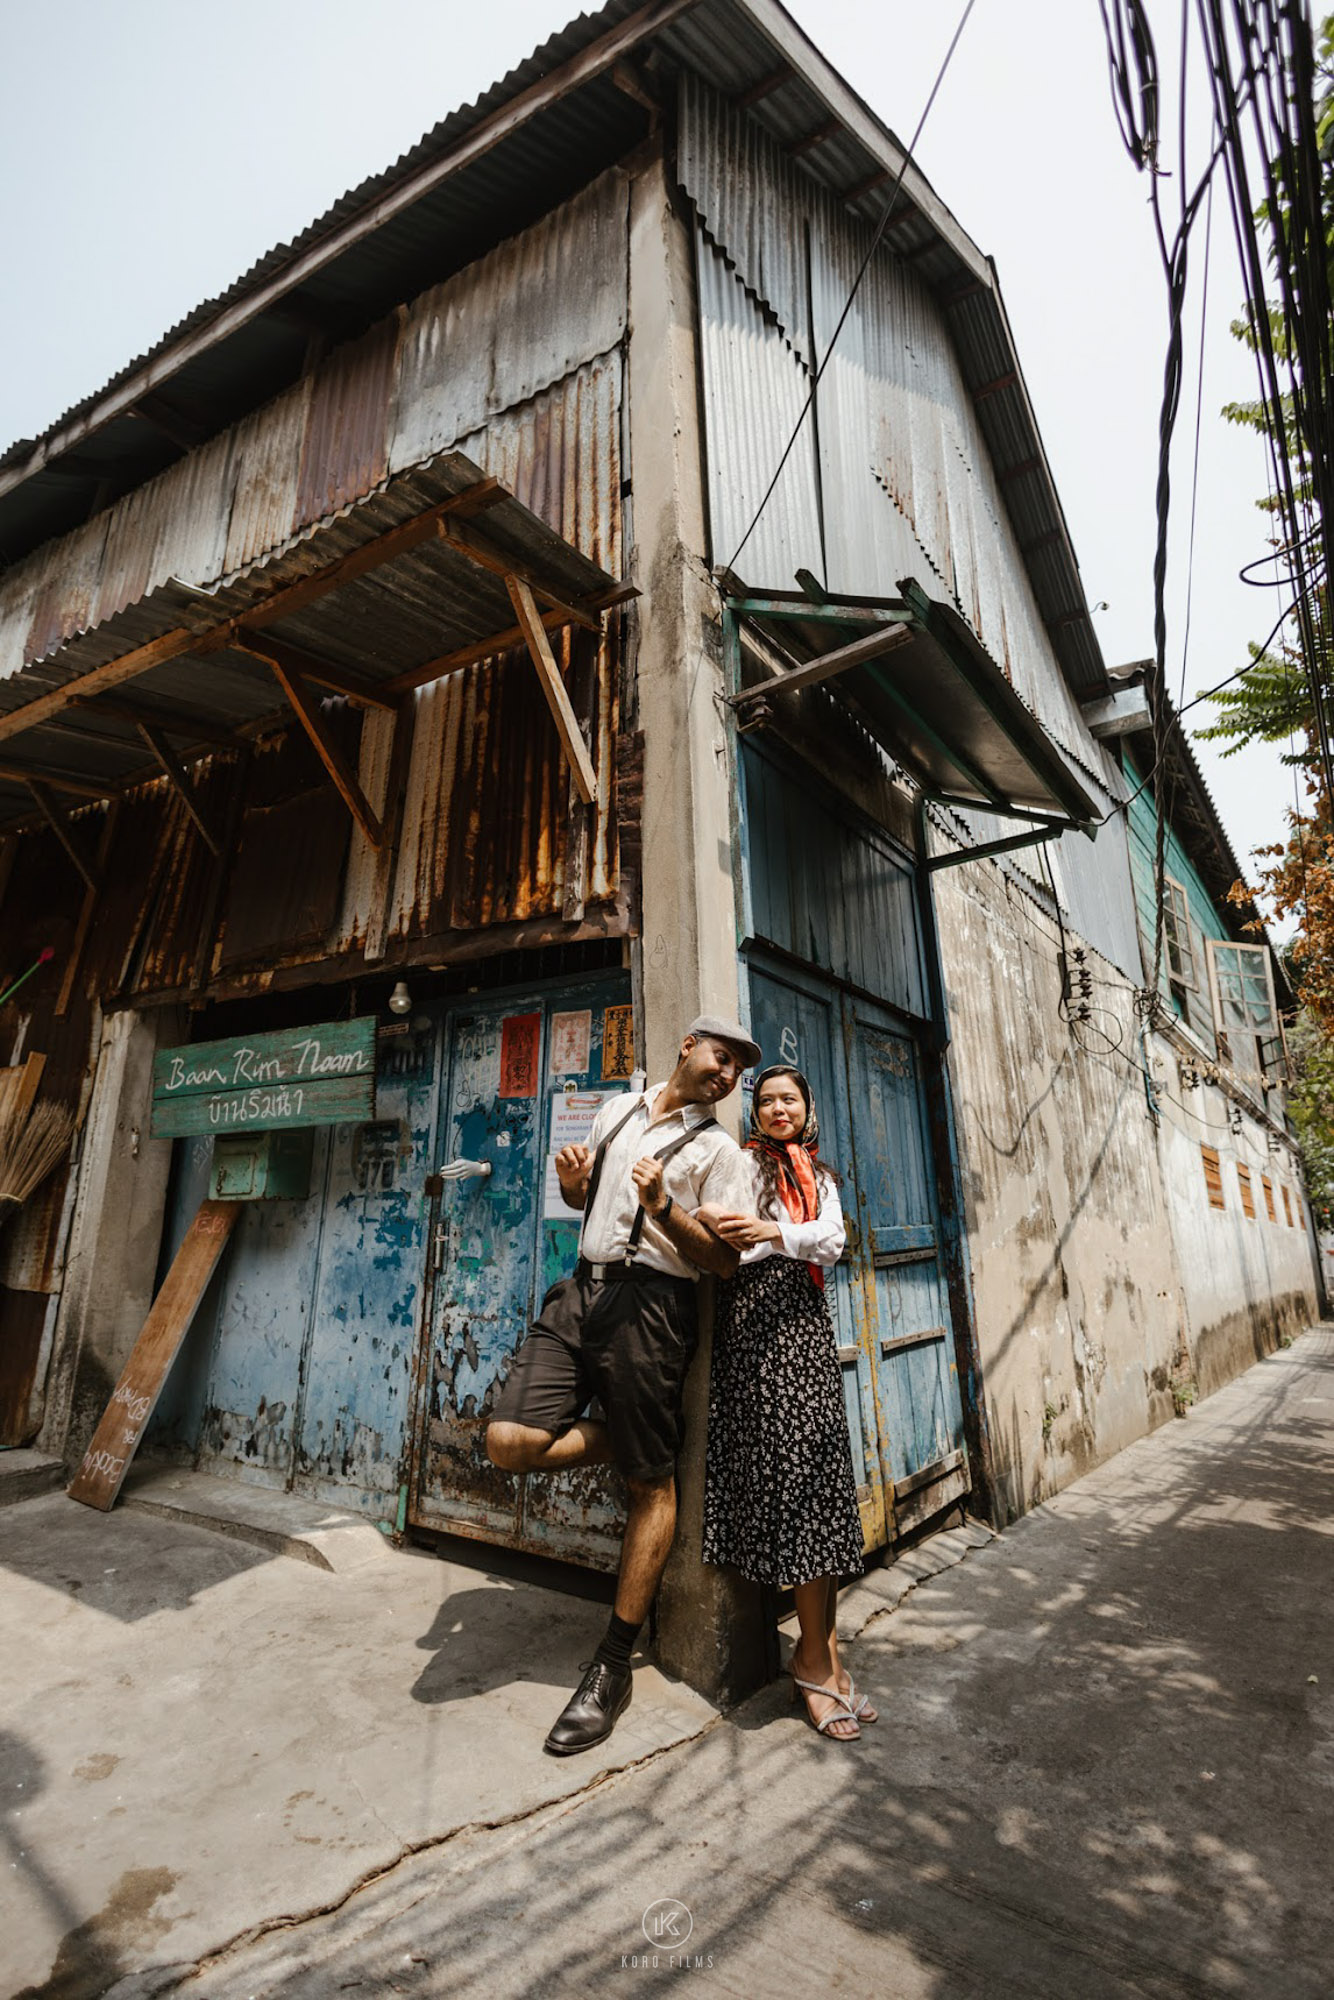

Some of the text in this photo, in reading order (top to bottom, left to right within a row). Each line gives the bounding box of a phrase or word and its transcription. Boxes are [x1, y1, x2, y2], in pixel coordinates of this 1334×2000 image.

[165, 1038, 370, 1090] Baan Rim Naam
